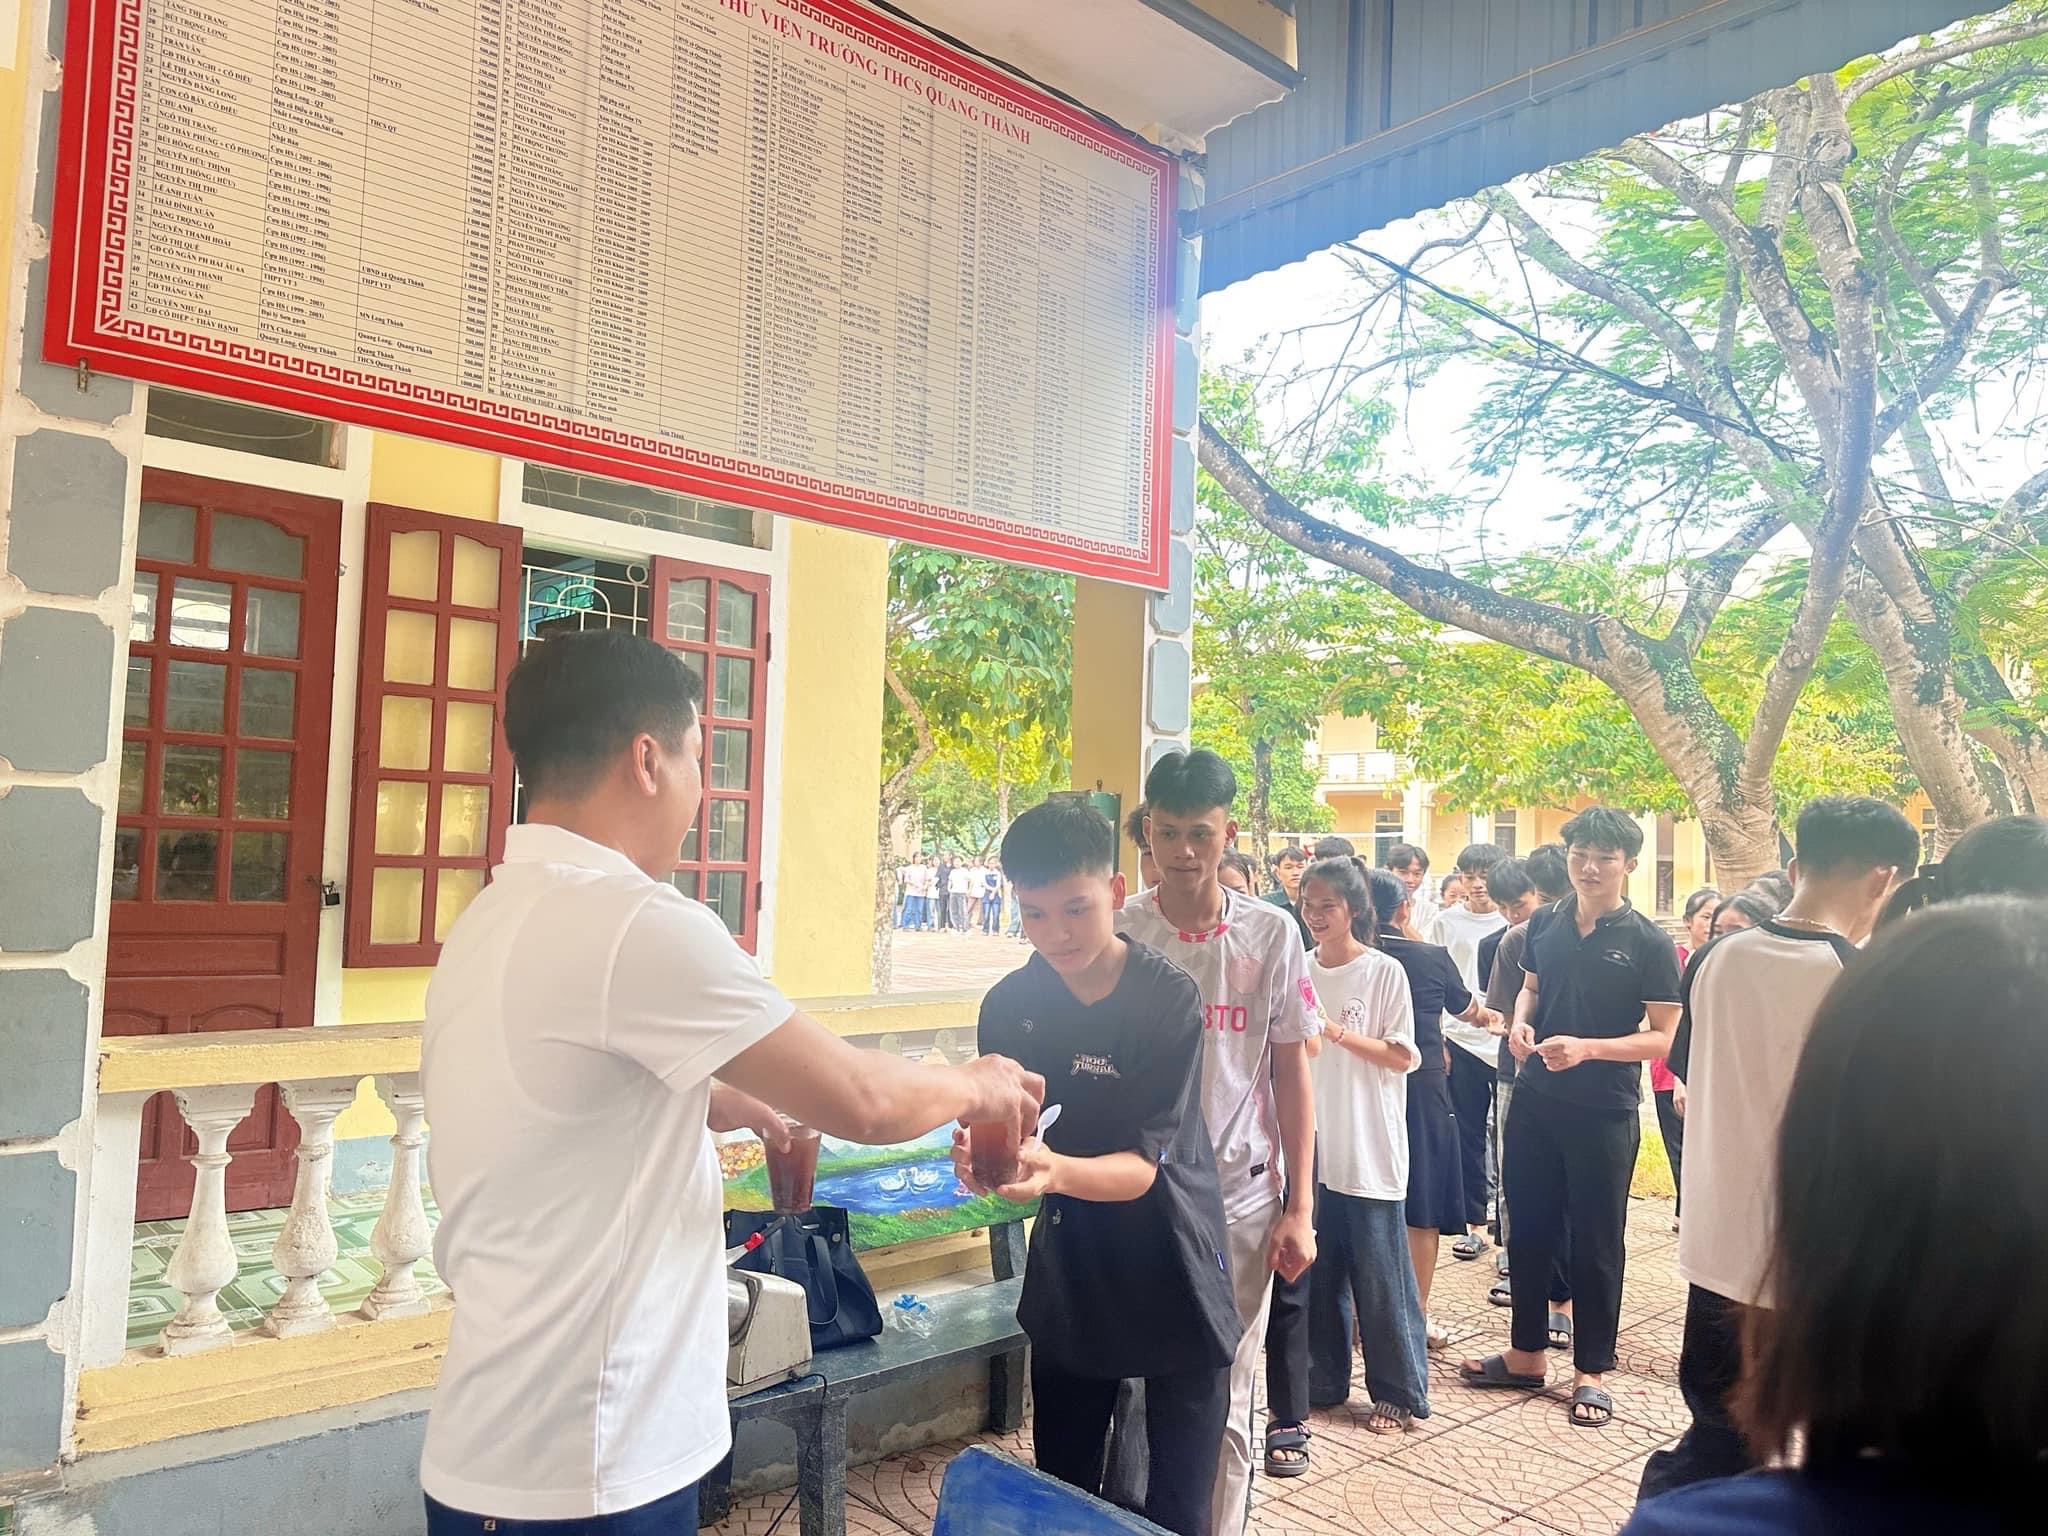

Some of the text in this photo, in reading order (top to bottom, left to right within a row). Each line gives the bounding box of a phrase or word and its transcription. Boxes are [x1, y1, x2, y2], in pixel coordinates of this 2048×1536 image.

[760, 9, 802, 40] VIỆN
[807, 30, 878, 76] TRƯỜNG
[881, 64, 922, 95] THCS
[926, 86, 978, 121] QUANG
[981, 110, 1030, 145] THÀNH
